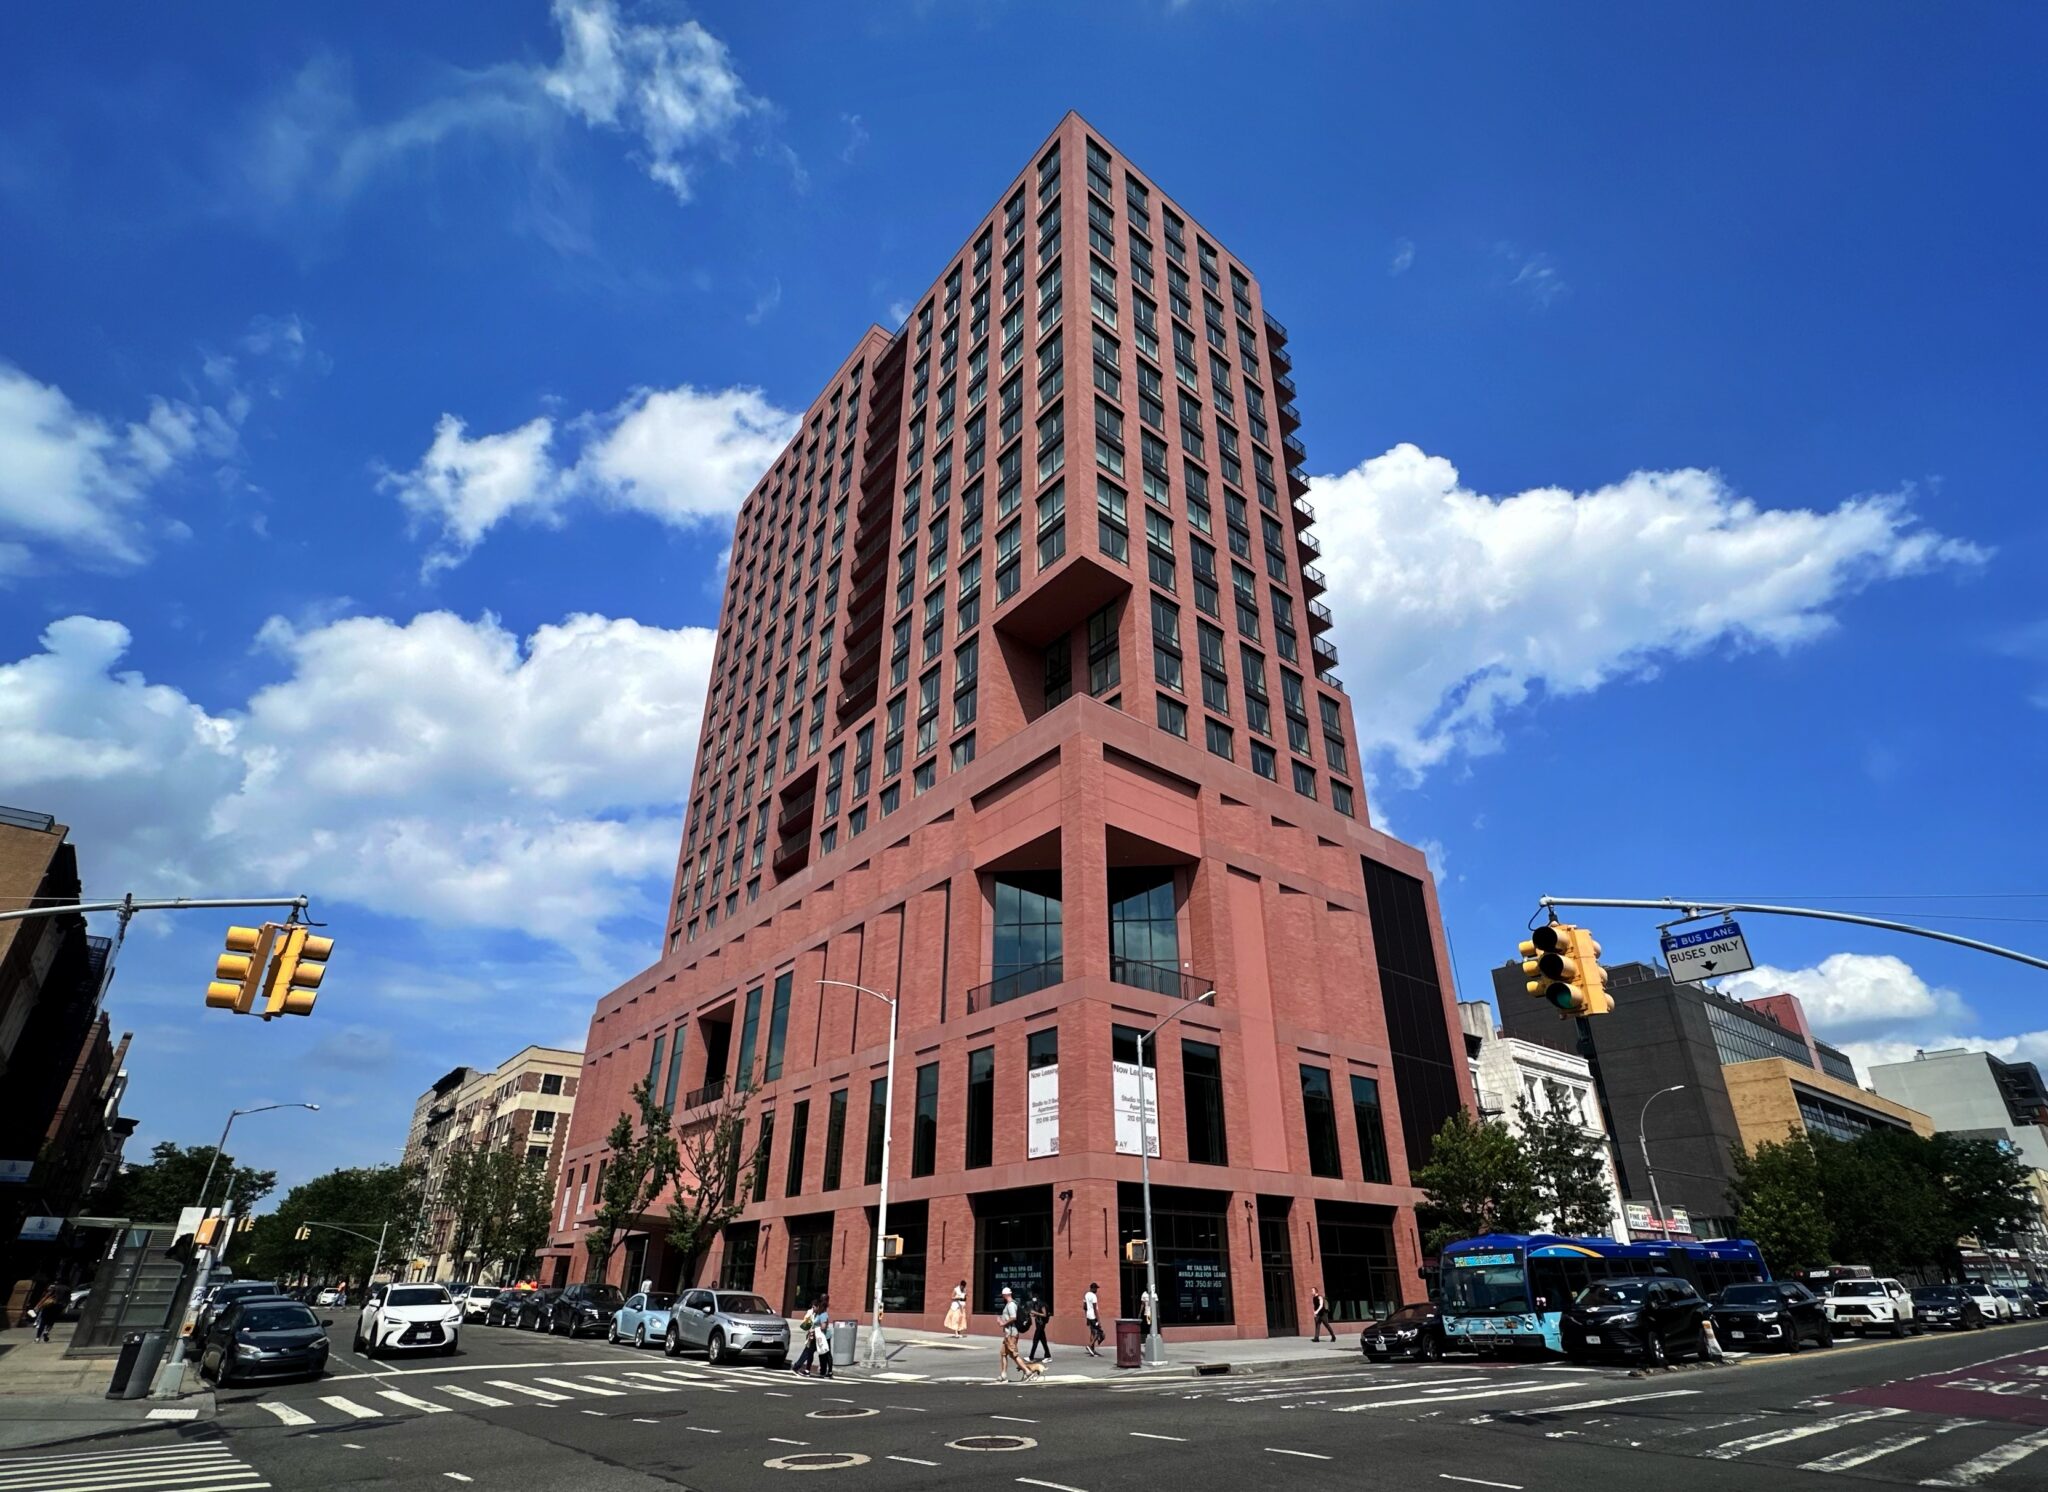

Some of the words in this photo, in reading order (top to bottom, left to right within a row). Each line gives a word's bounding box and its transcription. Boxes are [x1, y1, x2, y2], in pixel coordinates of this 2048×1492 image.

[1681, 934, 1702, 945] BUS
[1704, 926, 1735, 940] LANE
[1670, 948, 1706, 963] BUSES
[1710, 940, 1739, 955] ONLY
[1031, 1071, 1041, 1079] Now
[1113, 1064, 1128, 1074] Now
[1130, 1067, 1154, 1080] Leaing
